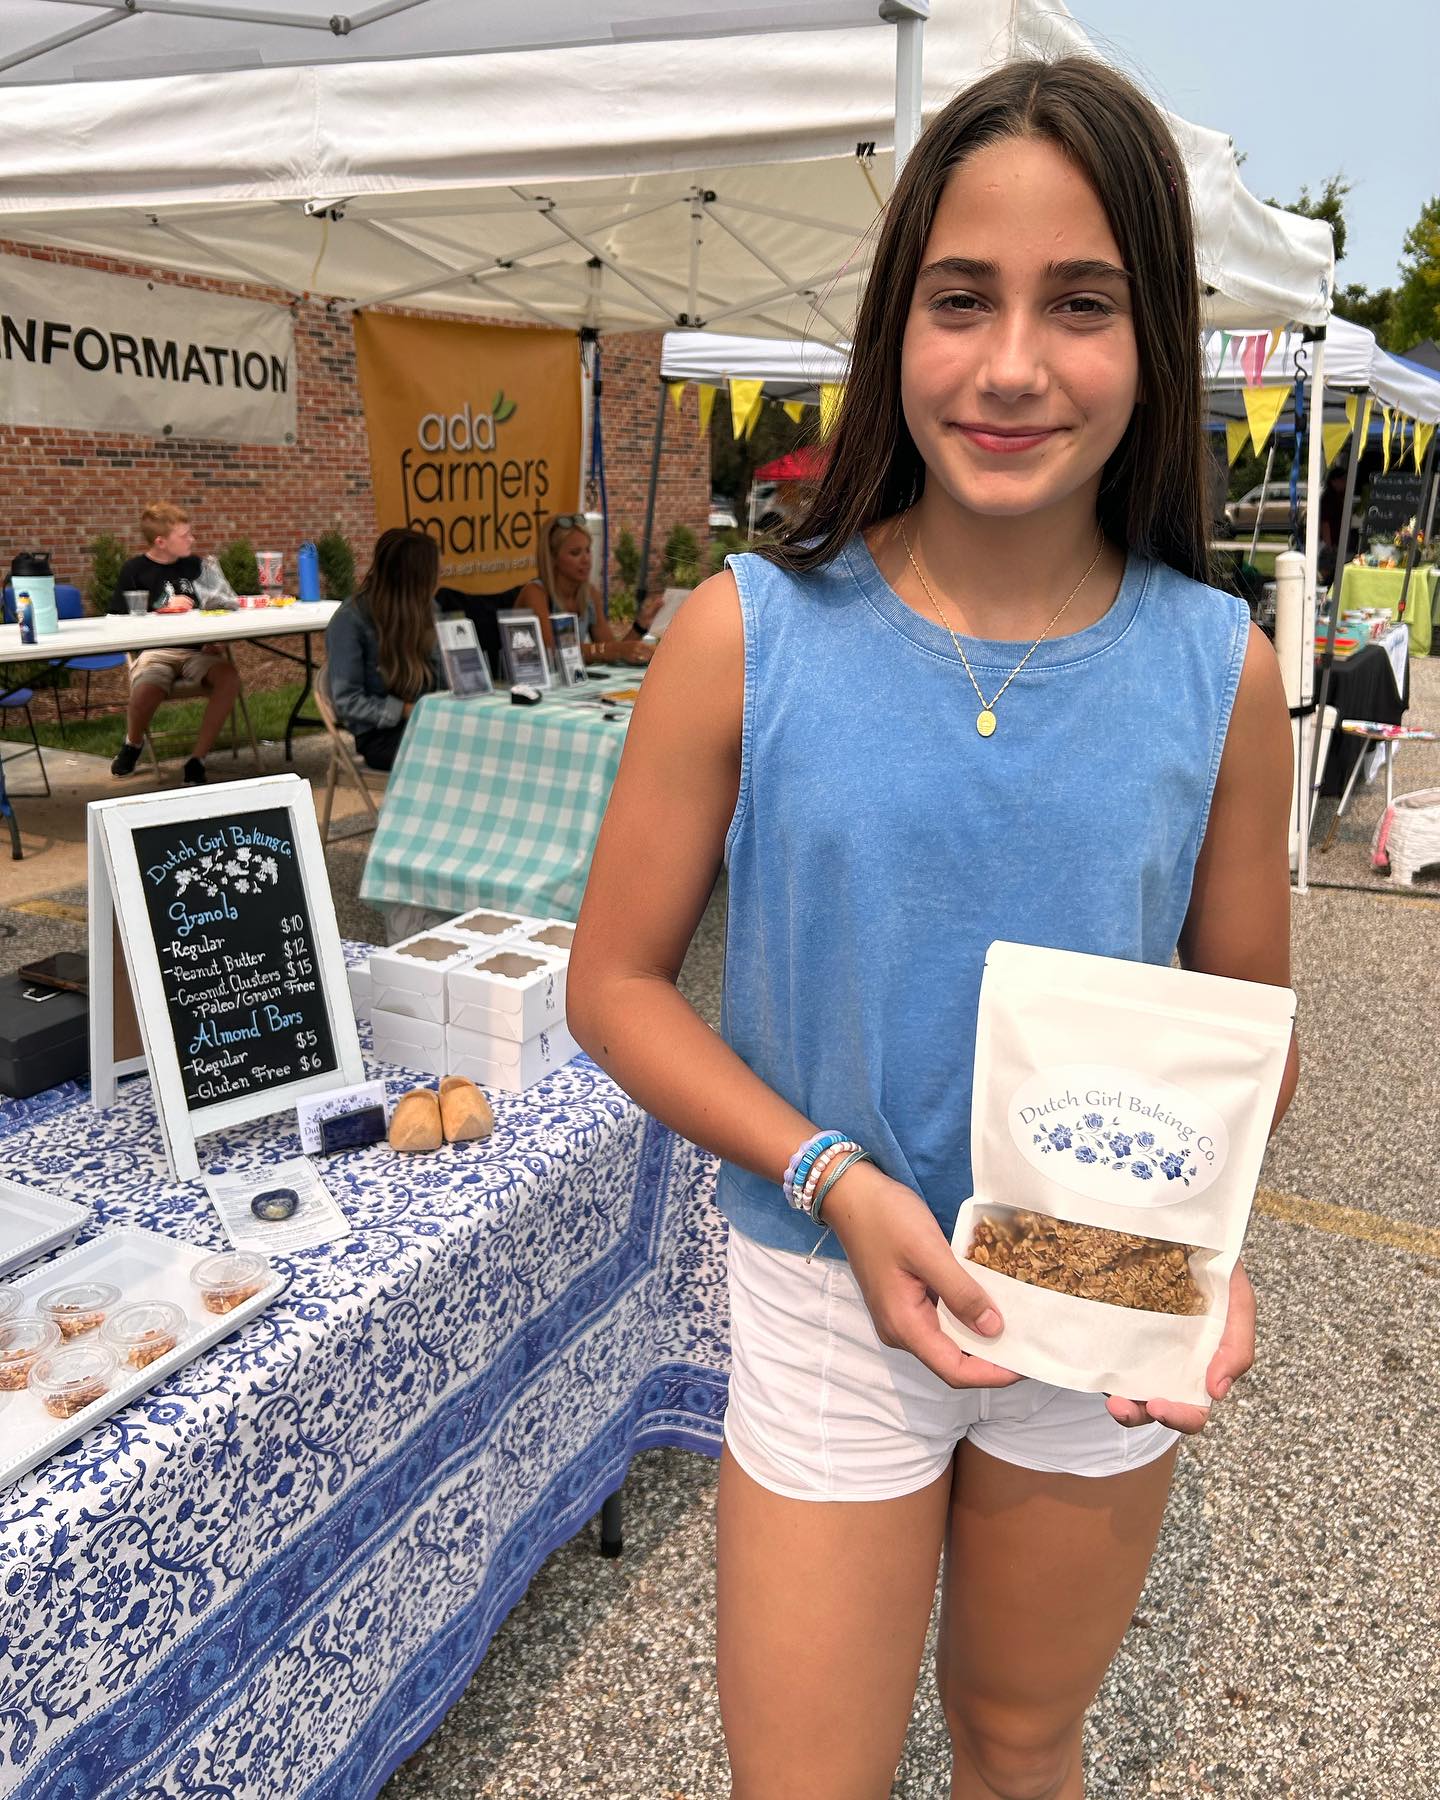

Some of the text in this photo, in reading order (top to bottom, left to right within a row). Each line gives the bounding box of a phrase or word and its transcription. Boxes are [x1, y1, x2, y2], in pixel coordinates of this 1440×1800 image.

[0, 314, 289, 393] NFORMATION
[418, 402, 496, 451] ada
[401, 448, 549, 503] farmers
[408, 499, 549, 555] market
[147, 840, 197, 885] Dutch
[198, 829, 228, 852] Girl
[229, 826, 281, 851] Baking
[169, 892, 239, 937] Granola
[281, 914, 304, 934] $10
[223, 951, 266, 972] Butter
[283, 937, 308, 959] $12
[229, 969, 281, 993] Clusters
[286, 957, 313, 978] $15
[283, 977, 316, 995] Free
[189, 1004, 304, 1054] Almond Bars
[296, 1029, 318, 1049] $5
[251, 1063, 292, 1083] Free
[300, 1052, 322, 1073] $6
[1018, 1089, 1216, 1167] Dutch Girl Baking Co.
